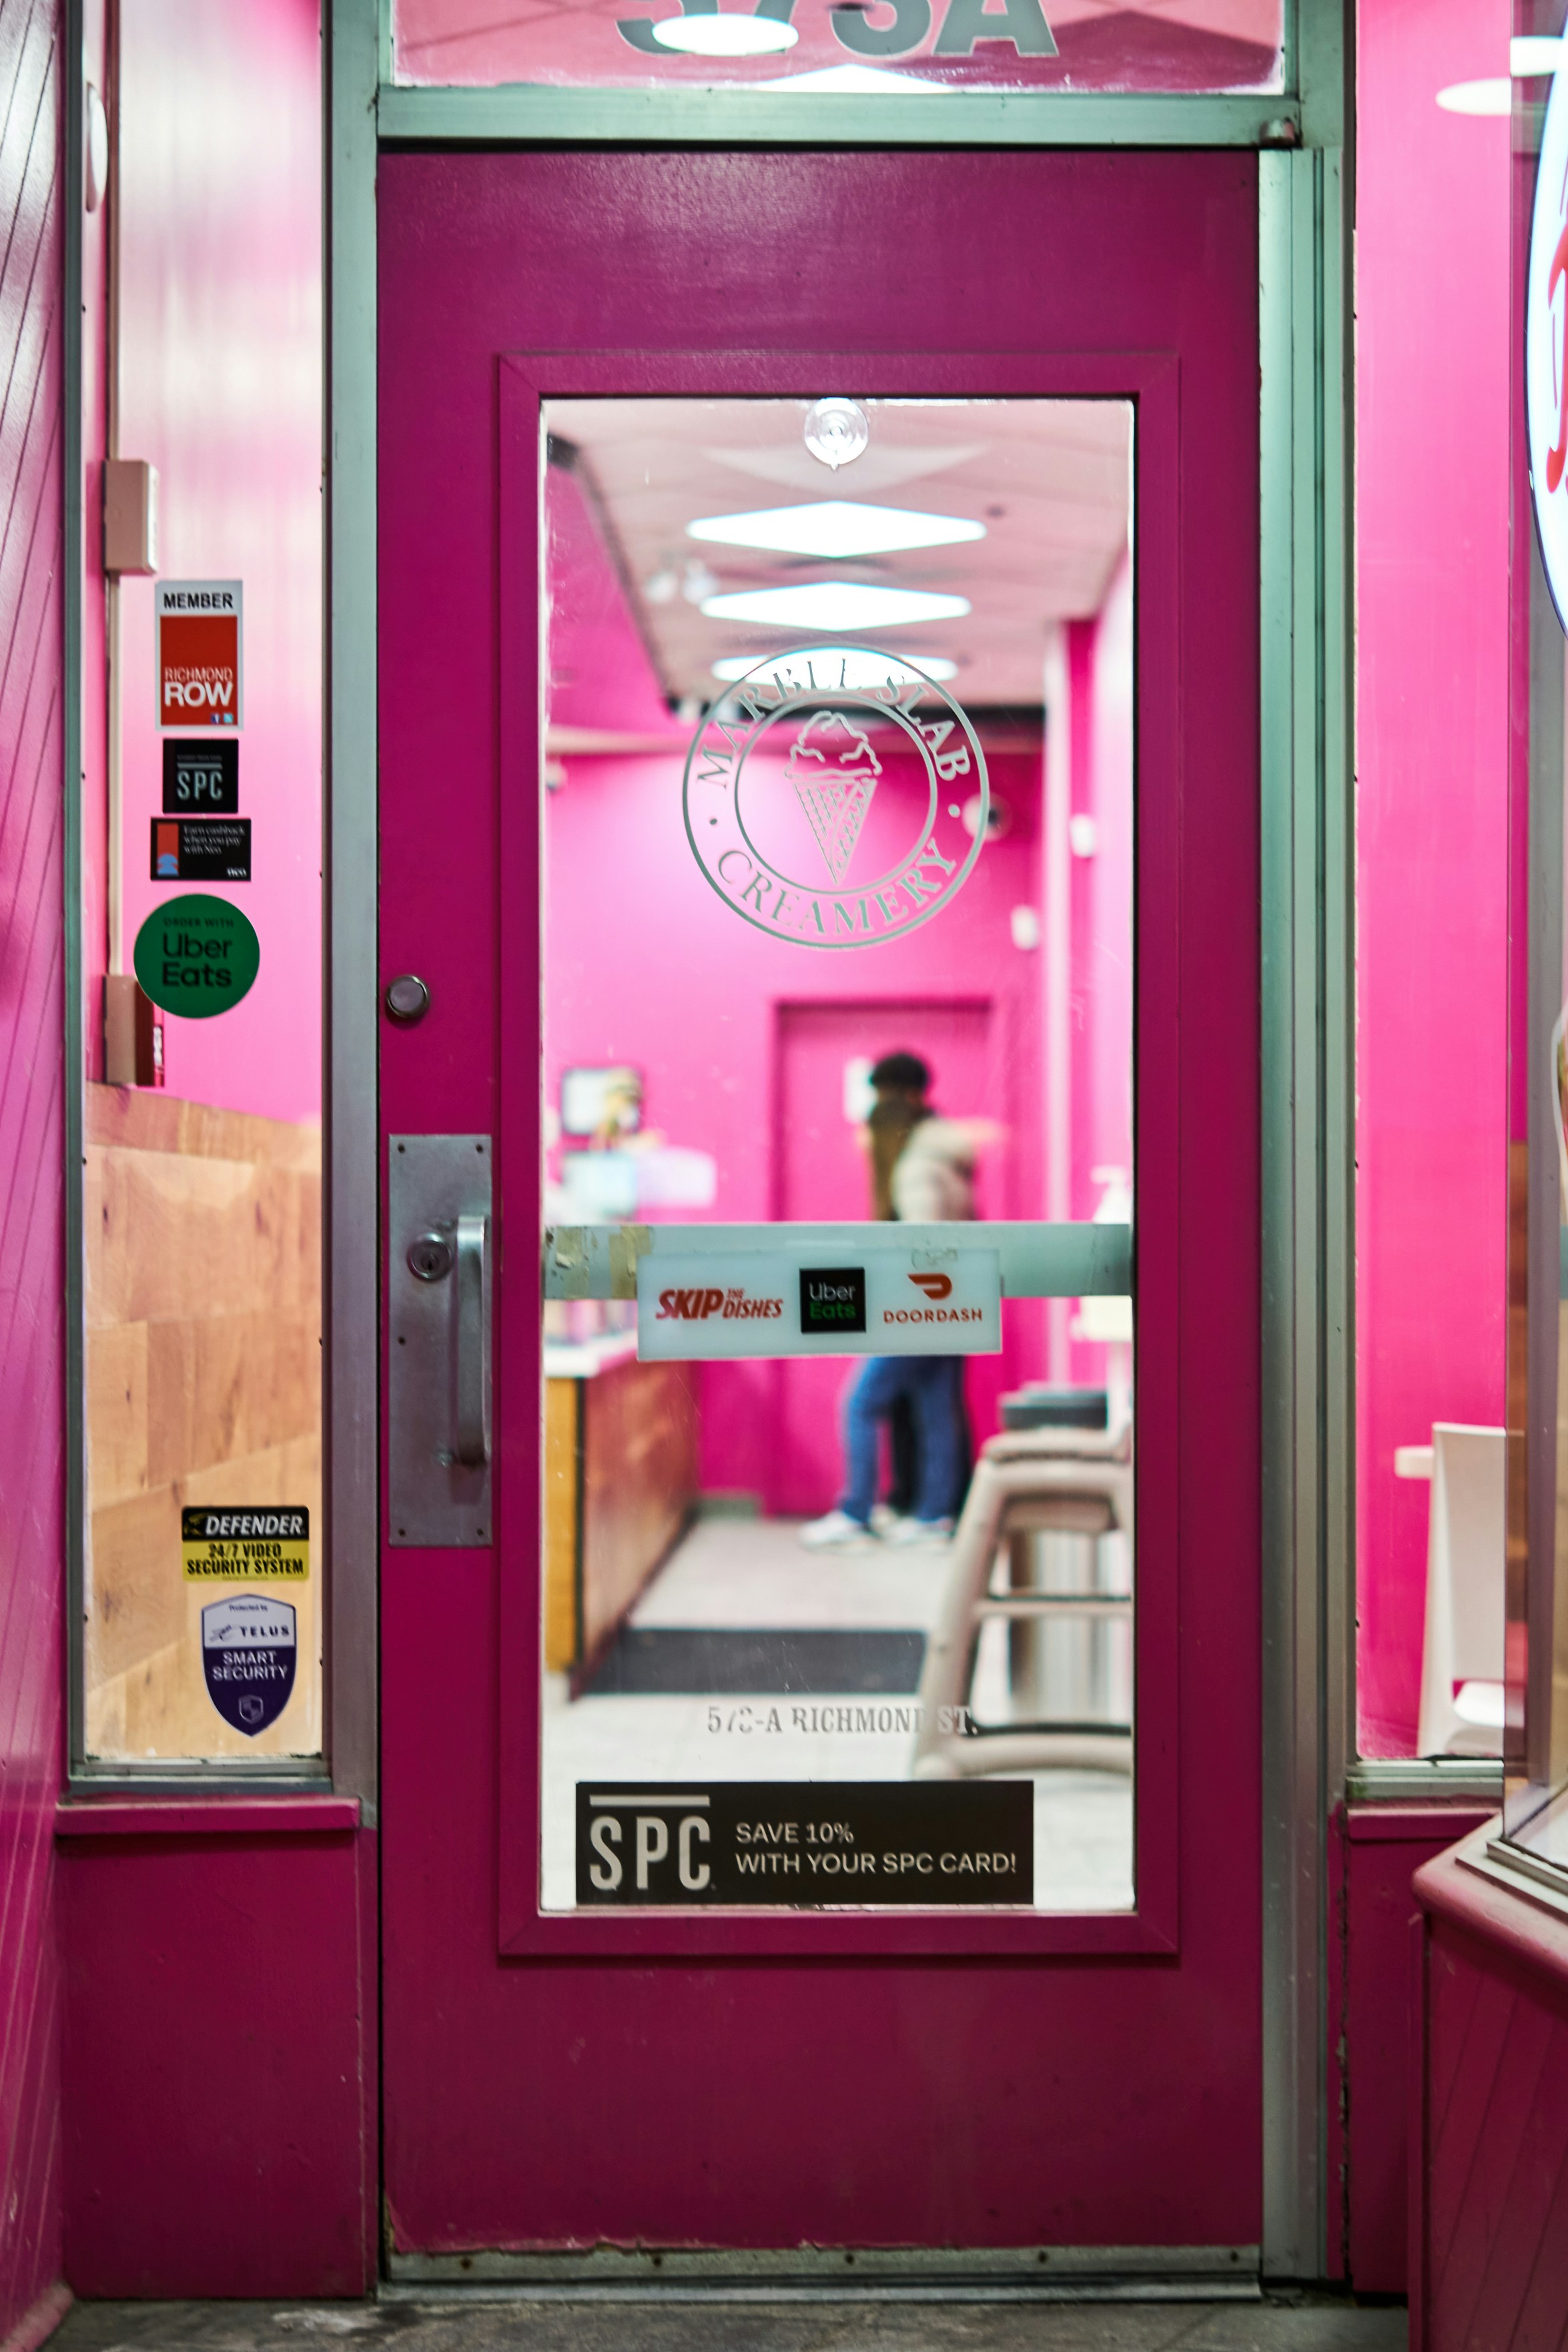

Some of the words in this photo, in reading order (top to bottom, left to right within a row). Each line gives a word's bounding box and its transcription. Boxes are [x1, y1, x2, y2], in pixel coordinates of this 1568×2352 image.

[163, 593, 234, 609] MEMBER
[164, 667, 233, 683] RICHMOND
[164, 681, 233, 707] ROW
[875, 675, 971, 782] SLAB
[177, 770, 223, 801] SPC
[717, 838, 957, 935] CREAMERY
[163, 932, 234, 959] Uber
[162, 961, 232, 988] Eats
[809, 1282, 856, 1302] Uber
[656, 1288, 725, 1320] SKIP
[722, 1298, 784, 1320] DISHES
[809, 1301, 857, 1320] Eats
[883, 1308, 982, 1324] DOORDASH
[206, 1515, 304, 1536] DEFENDER
[209, 1543, 239, 1558] 24/7
[243, 1543, 282, 1558] VIDEO
[187, 1559, 250, 1575] SECURITY
[254, 1558, 304, 1575] SYSTEM
[240, 1625, 290, 1637] TELUS
[222, 1651, 278, 1665] SMART
[212, 1665, 288, 1681] SECURITY
[735, 1822, 799, 1844] SAVE
[806, 1822, 855, 1844] 10%
[589, 1815, 711, 1891] SPC
[735, 1853, 801, 1874] WITH
[807, 1852, 877, 1874] YOUR
[882, 1852, 934, 1874] SPC
[939, 1852, 1017, 1874] CARD!
